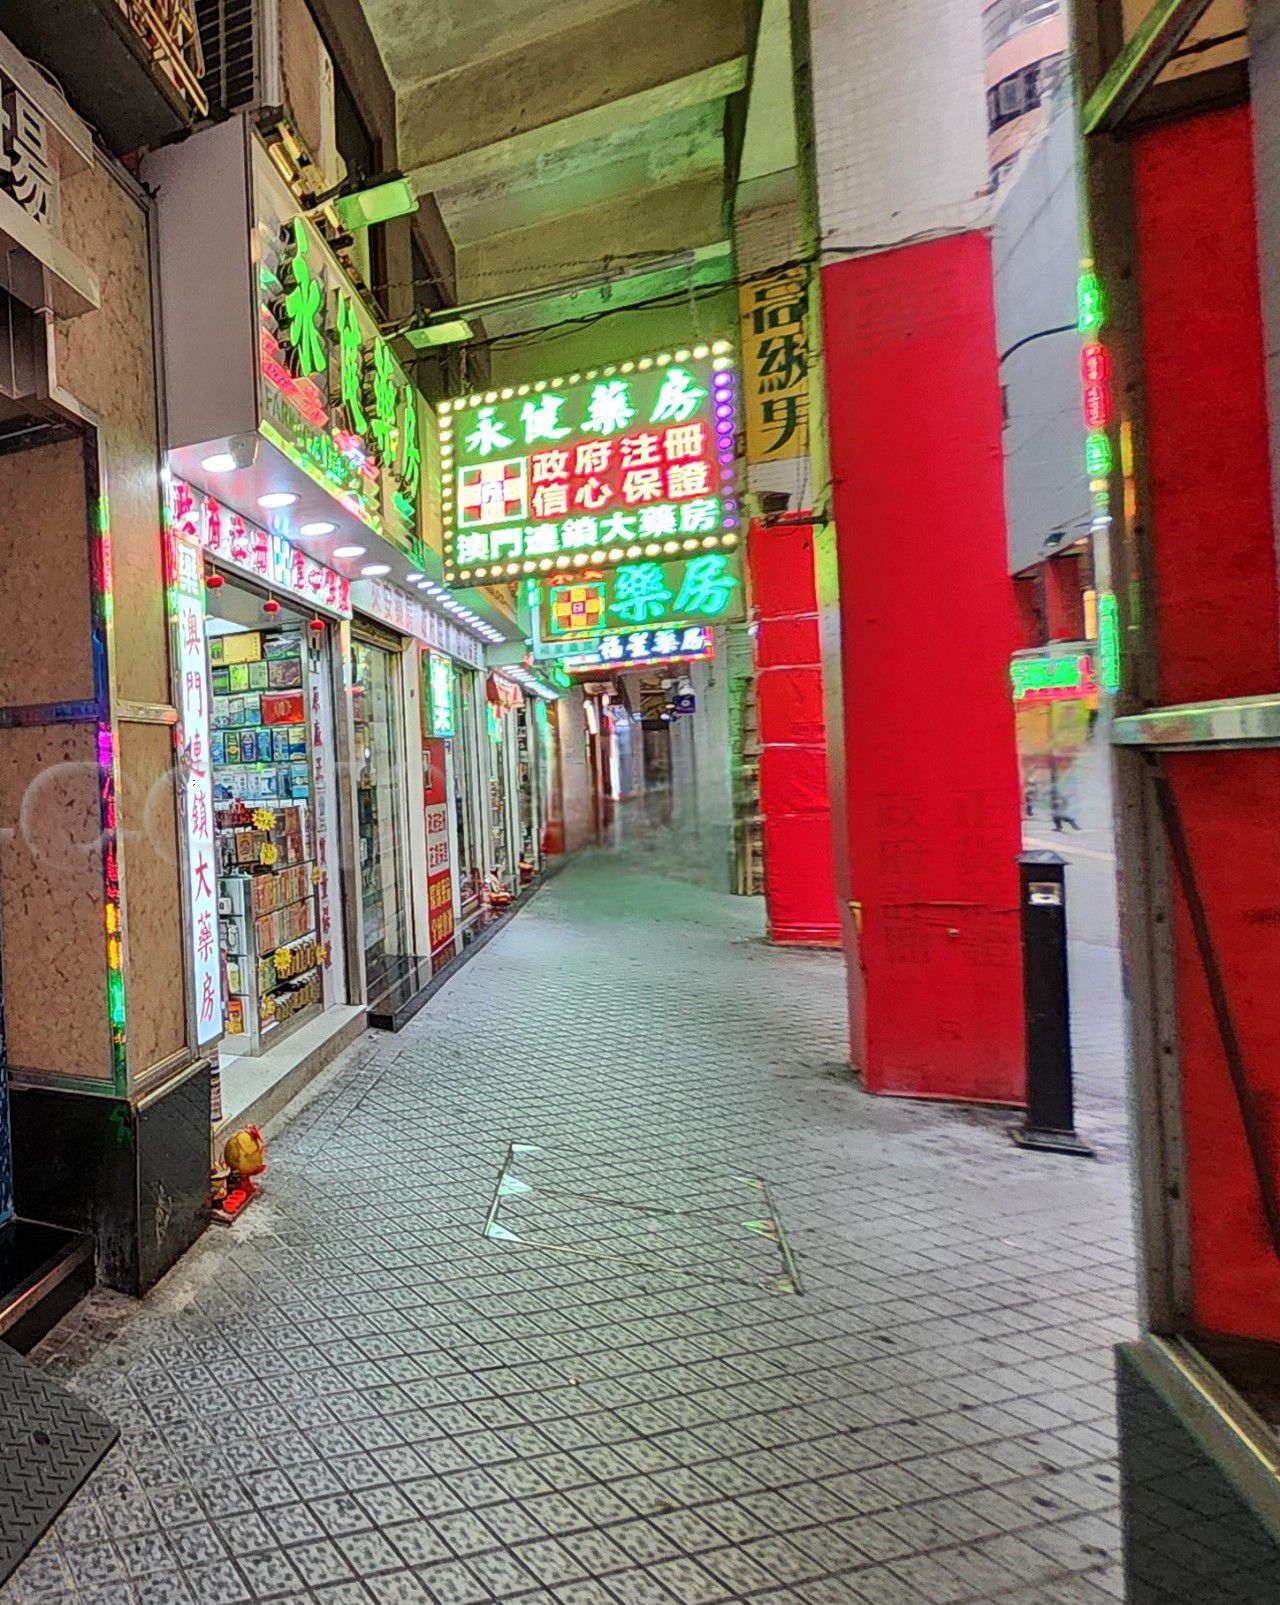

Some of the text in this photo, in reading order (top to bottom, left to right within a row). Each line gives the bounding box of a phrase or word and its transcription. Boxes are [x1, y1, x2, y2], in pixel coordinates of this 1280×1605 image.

[464, 368, 709, 457] 永健藥房
[531, 461, 713, 519] 信心保證
[456, 497, 722, 565] 澳門連鎖大藥房
[180, 606, 217, 1024] 澳門連鎖大藥房
